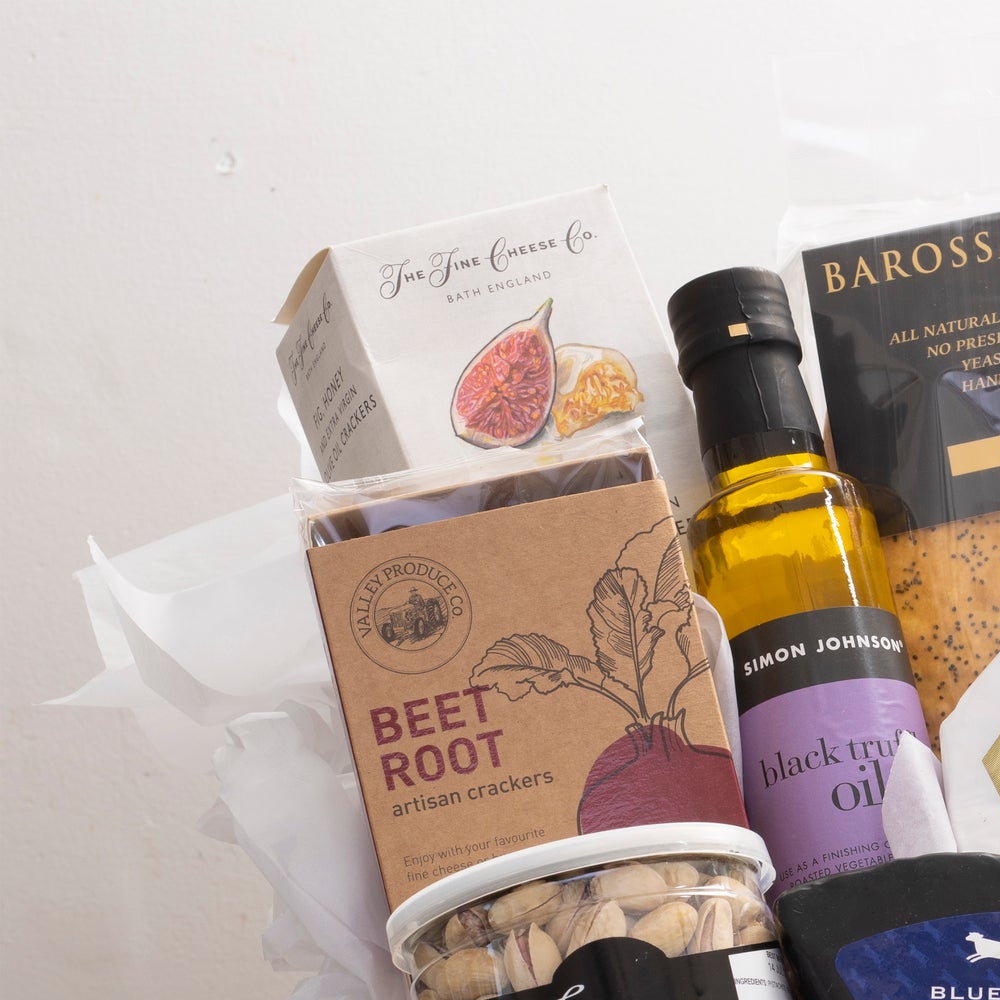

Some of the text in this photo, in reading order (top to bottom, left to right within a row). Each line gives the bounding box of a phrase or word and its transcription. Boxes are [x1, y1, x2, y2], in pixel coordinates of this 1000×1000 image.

[446, 269, 552, 304] BATH ENGLAND
[889, 328, 920, 346] ALL
[924, 311, 1000, 338] NATURAL
[926, 341, 952, 359] NO
[322, 366, 344, 411] HONEY
[338, 384, 358, 415] VIRGIN
[332, 440, 342, 462] OIL
[340, 393, 378, 446] CRACKERS
[357, 574, 384, 638] VALLEY
[381, 562, 457, 595] PRODUCE
[743, 642, 806, 677] SIMON
[369, 684, 491, 747] BEET
[379, 730, 504, 791] ROOT
[758, 736, 844, 789] black
[391, 768, 554, 818] artisan crackers
[831, 758, 887, 812] oil
[403, 828, 546, 868] Enjoy with your favourite
[779, 868, 794, 882] USE
[796, 861, 808, 873] AS
[812, 858, 820, 867] A
[822, 842, 880, 863] FINISHING
[407, 870, 430, 883] fine
[432, 859, 473, 878] cheese
